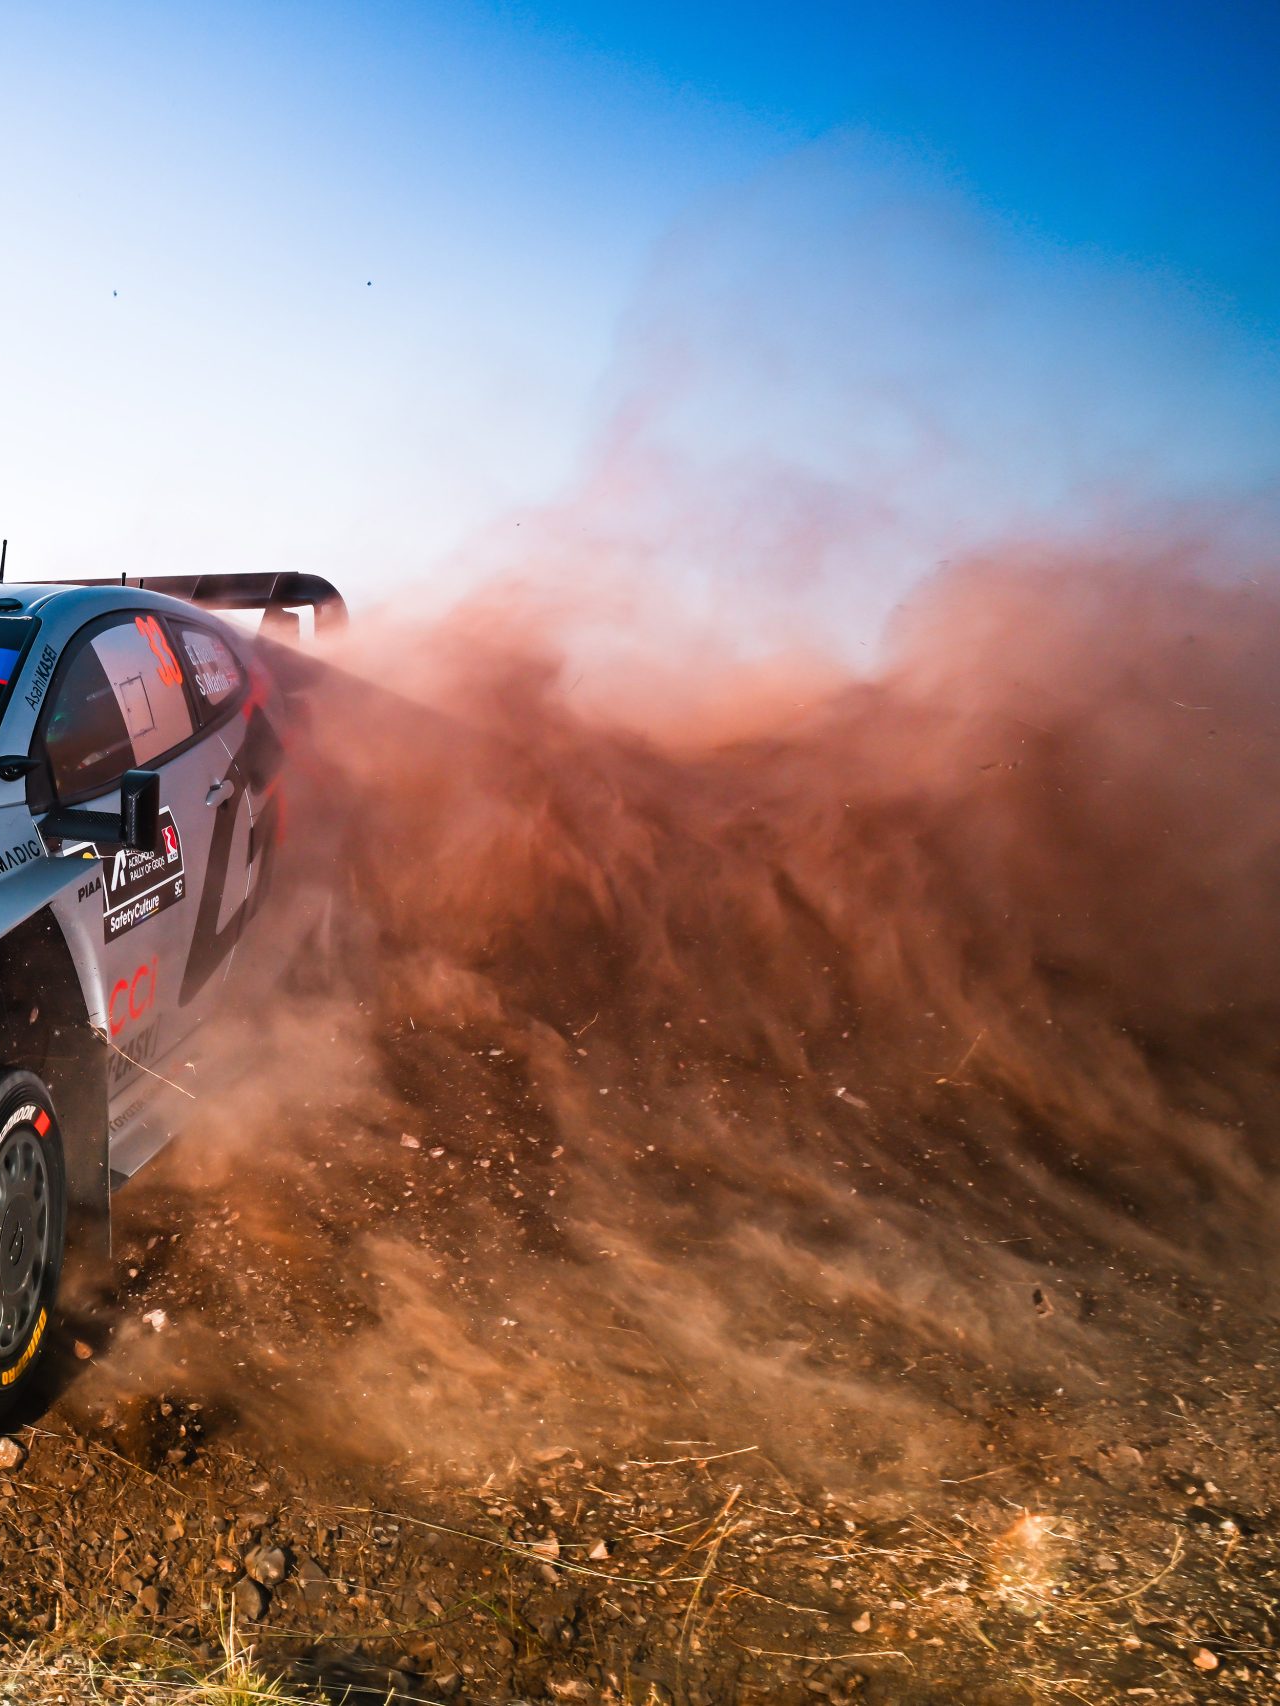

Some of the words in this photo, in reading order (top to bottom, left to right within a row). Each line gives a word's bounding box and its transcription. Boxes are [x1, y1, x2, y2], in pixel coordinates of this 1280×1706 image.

[135, 615, 183, 687] 33
[78, 877, 102, 903] PIAA
[110, 895, 160, 932] SafetyCulture
